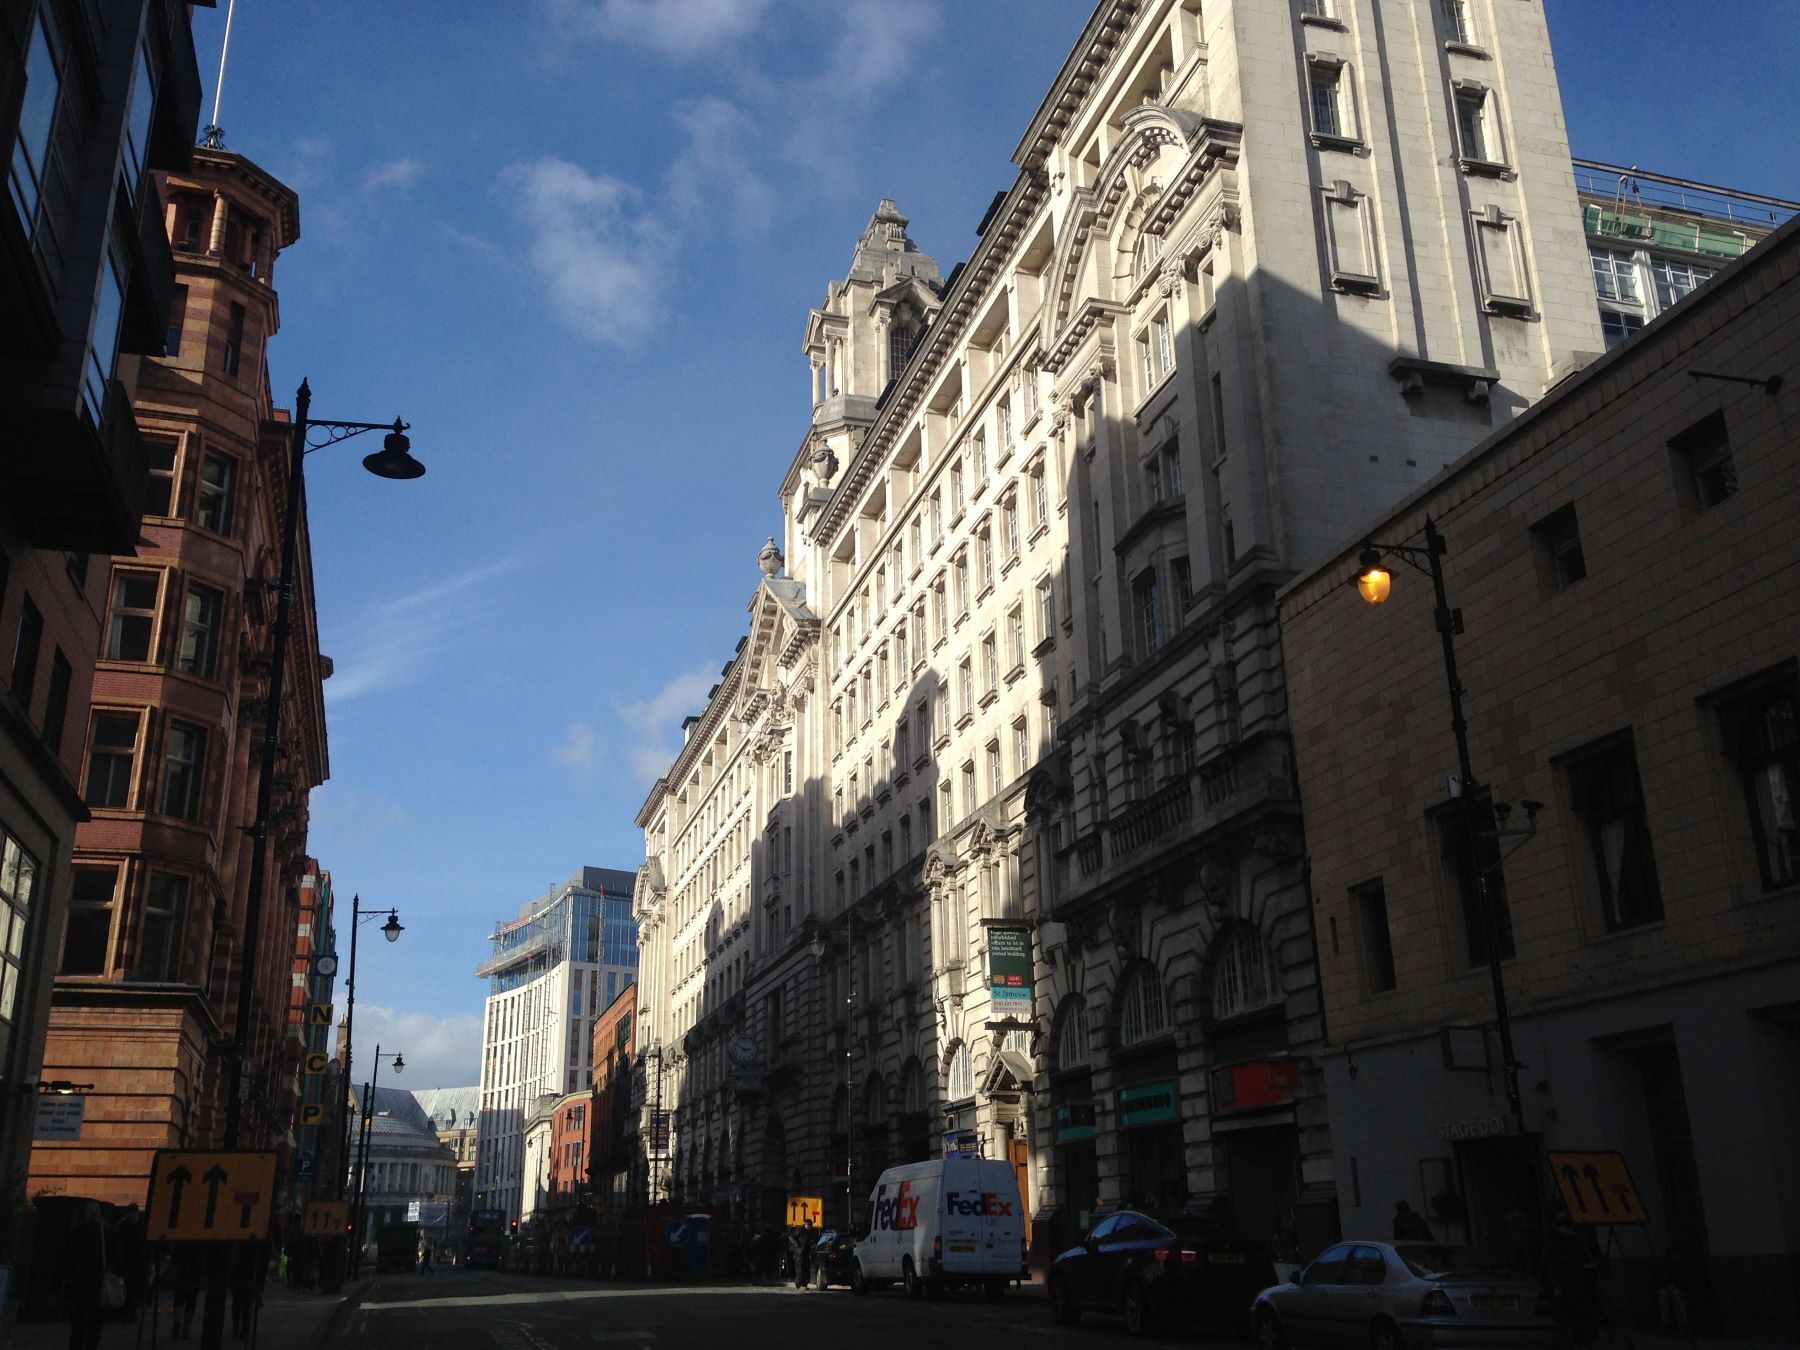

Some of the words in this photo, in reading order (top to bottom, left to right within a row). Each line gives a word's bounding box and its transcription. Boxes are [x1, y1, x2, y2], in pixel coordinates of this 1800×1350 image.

[1437, 1119, 1477, 1139] STAGE
[874, 1180, 921, 1231] FedEx
[946, 1192, 1013, 1216] FedEx
